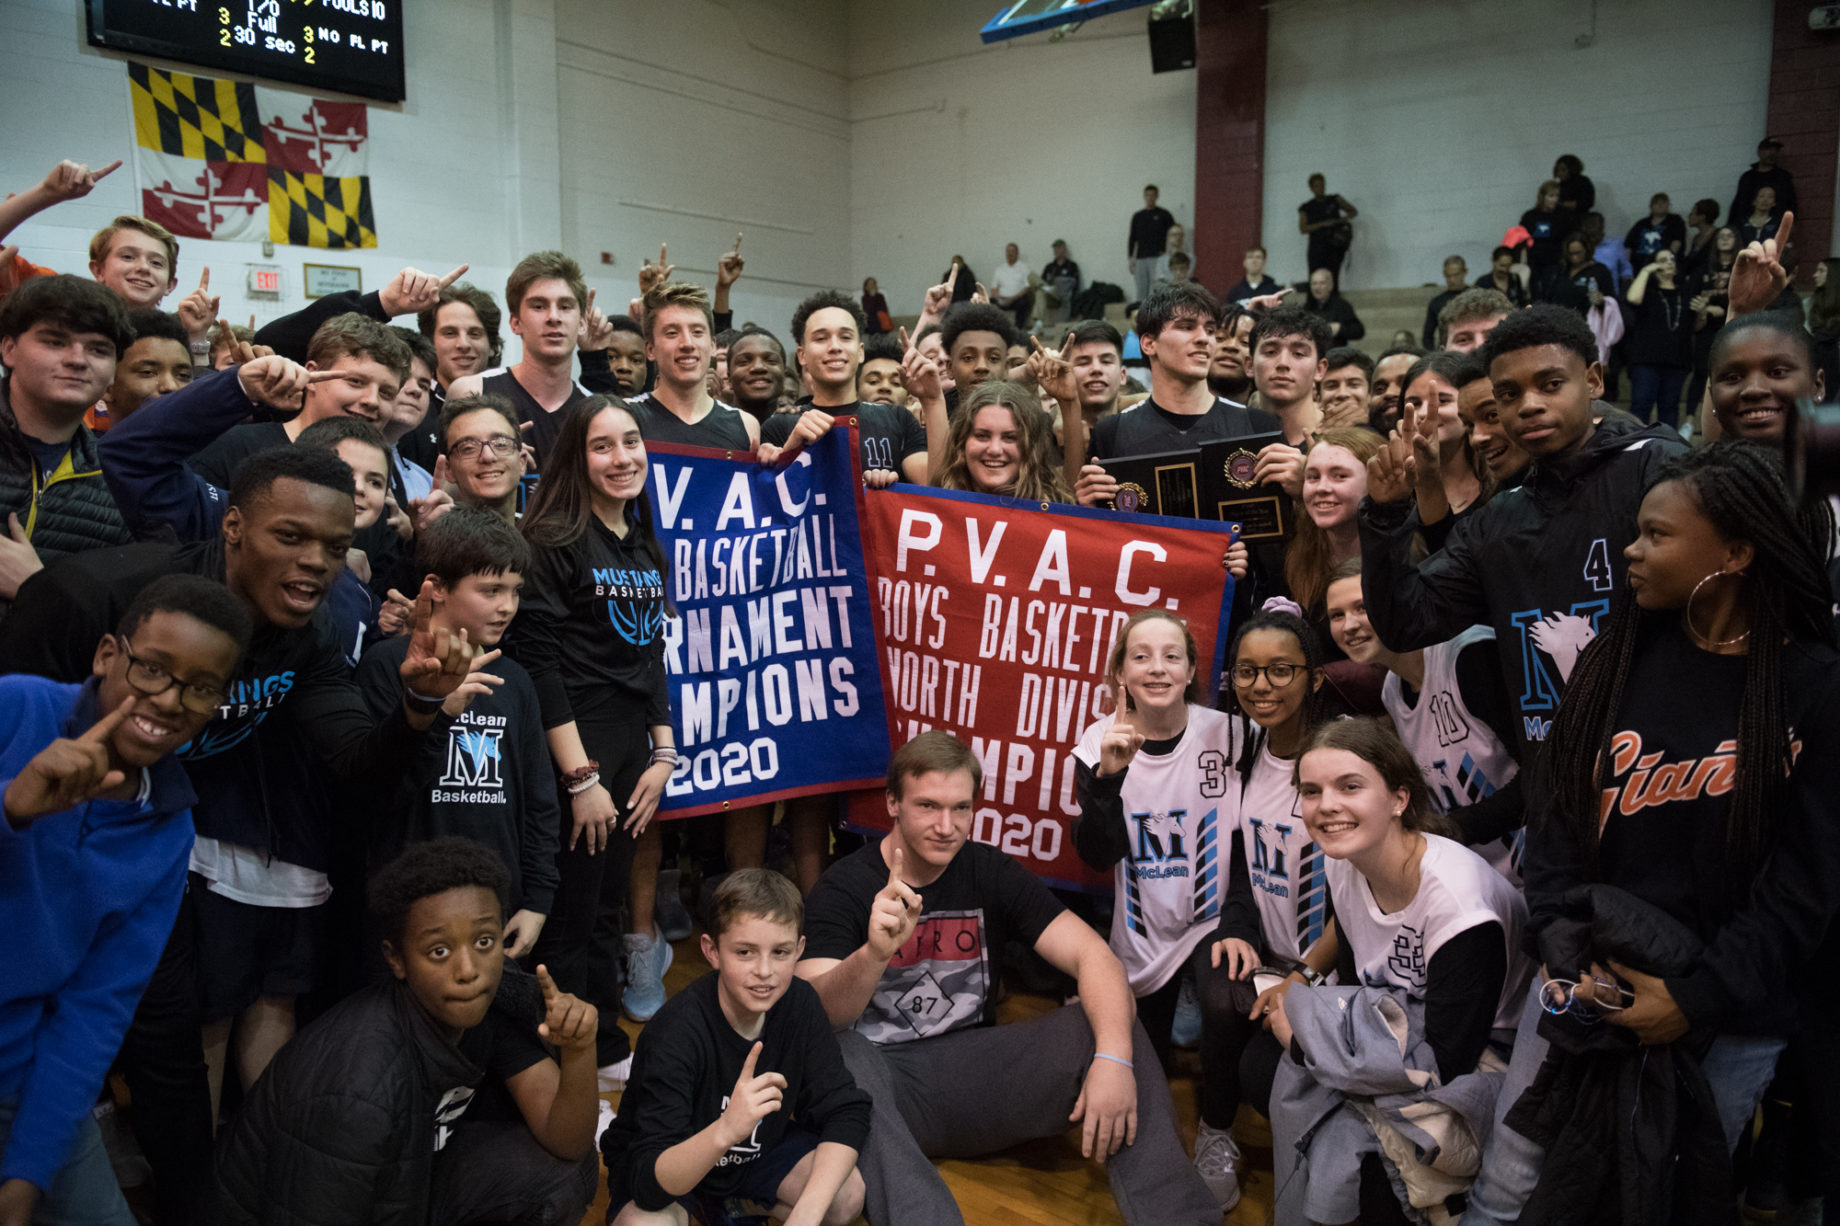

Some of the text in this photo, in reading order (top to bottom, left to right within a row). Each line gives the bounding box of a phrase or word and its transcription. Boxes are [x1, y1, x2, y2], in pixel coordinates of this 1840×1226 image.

[218, 6, 277, 34] 3 Full
[219, 25, 296, 54] 2 30 sec
[303, 25, 315, 44] 3
[371, 38, 389, 55] PT
[303, 46, 316, 64] 2
[257, 271, 278, 289] EXIT
[864, 437, 893, 469] 11
[674, 513, 847, 602] BASKETBALL
[1583, 538, 1613, 592] 4
[662, 584, 853, 675] RNAMENT
[878, 576, 949, 650] BOYS
[455, 710, 507, 727] cLean
[681, 656, 860, 747] MPIONS
[887, 645, 1112, 745] NORTH DIVIS
[1429, 690, 1470, 748] 10
[664, 736, 780, 798] 2020
[1198, 749, 1227, 799] 3
[967, 807, 1063, 861] 020
[1134, 864, 1189, 880] McLean
[911, 995, 939, 1015] 87
